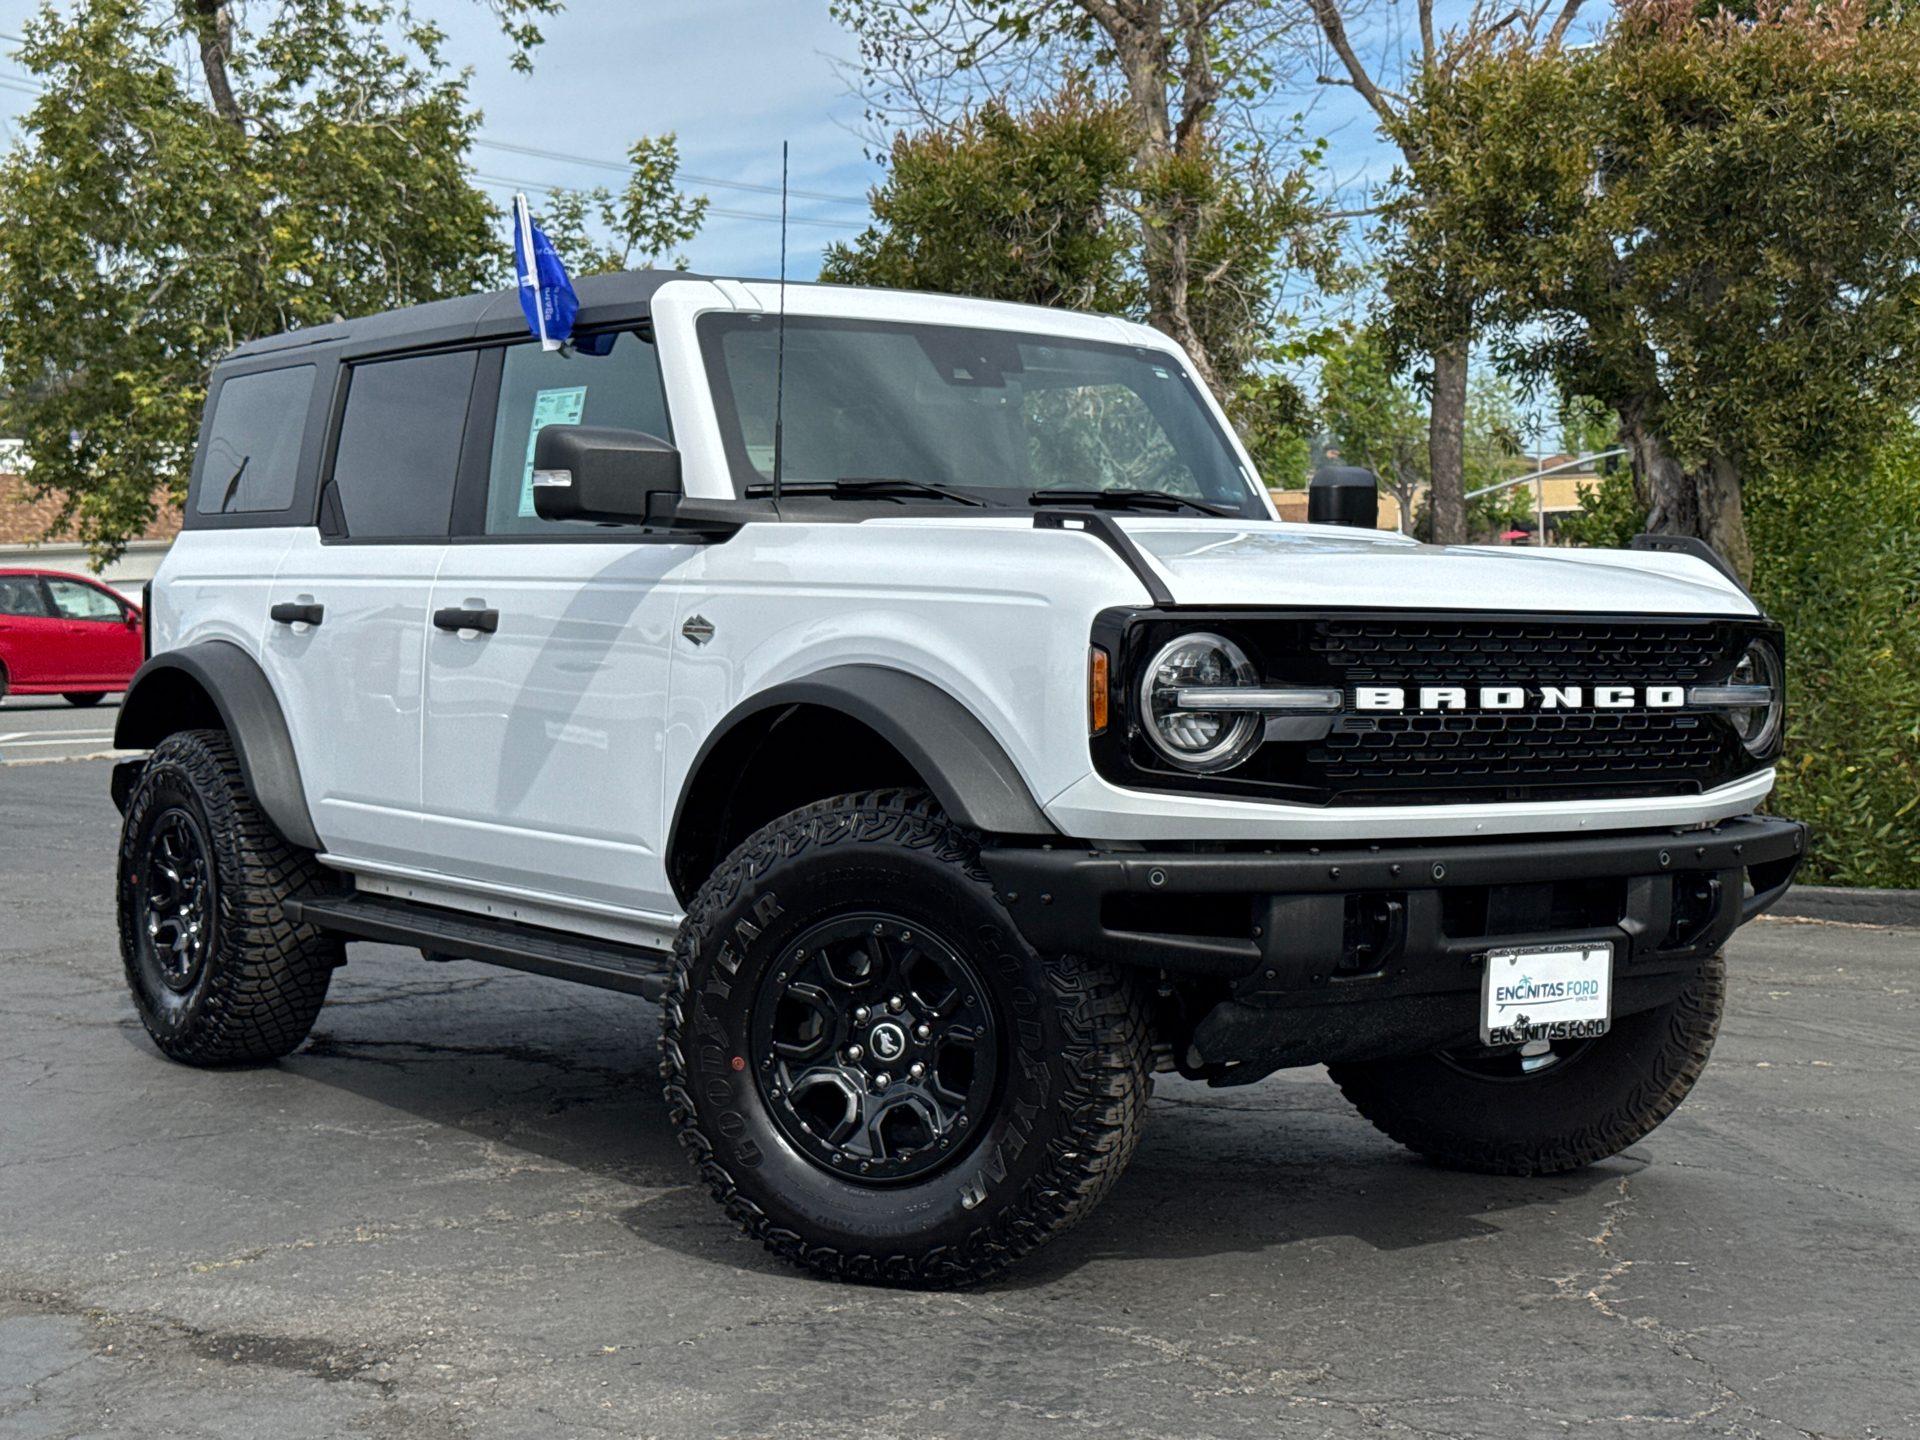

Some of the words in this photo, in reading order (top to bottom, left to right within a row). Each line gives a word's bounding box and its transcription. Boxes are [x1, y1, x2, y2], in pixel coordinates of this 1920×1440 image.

[1355, 686, 1685, 711] BRONCO
[1496, 981, 1564, 1002] ENCINITAS
[1566, 979, 1599, 996] FORD
[1490, 1021, 1567, 1044] ENCINITAS
[1569, 1019, 1605, 1038] FORD
